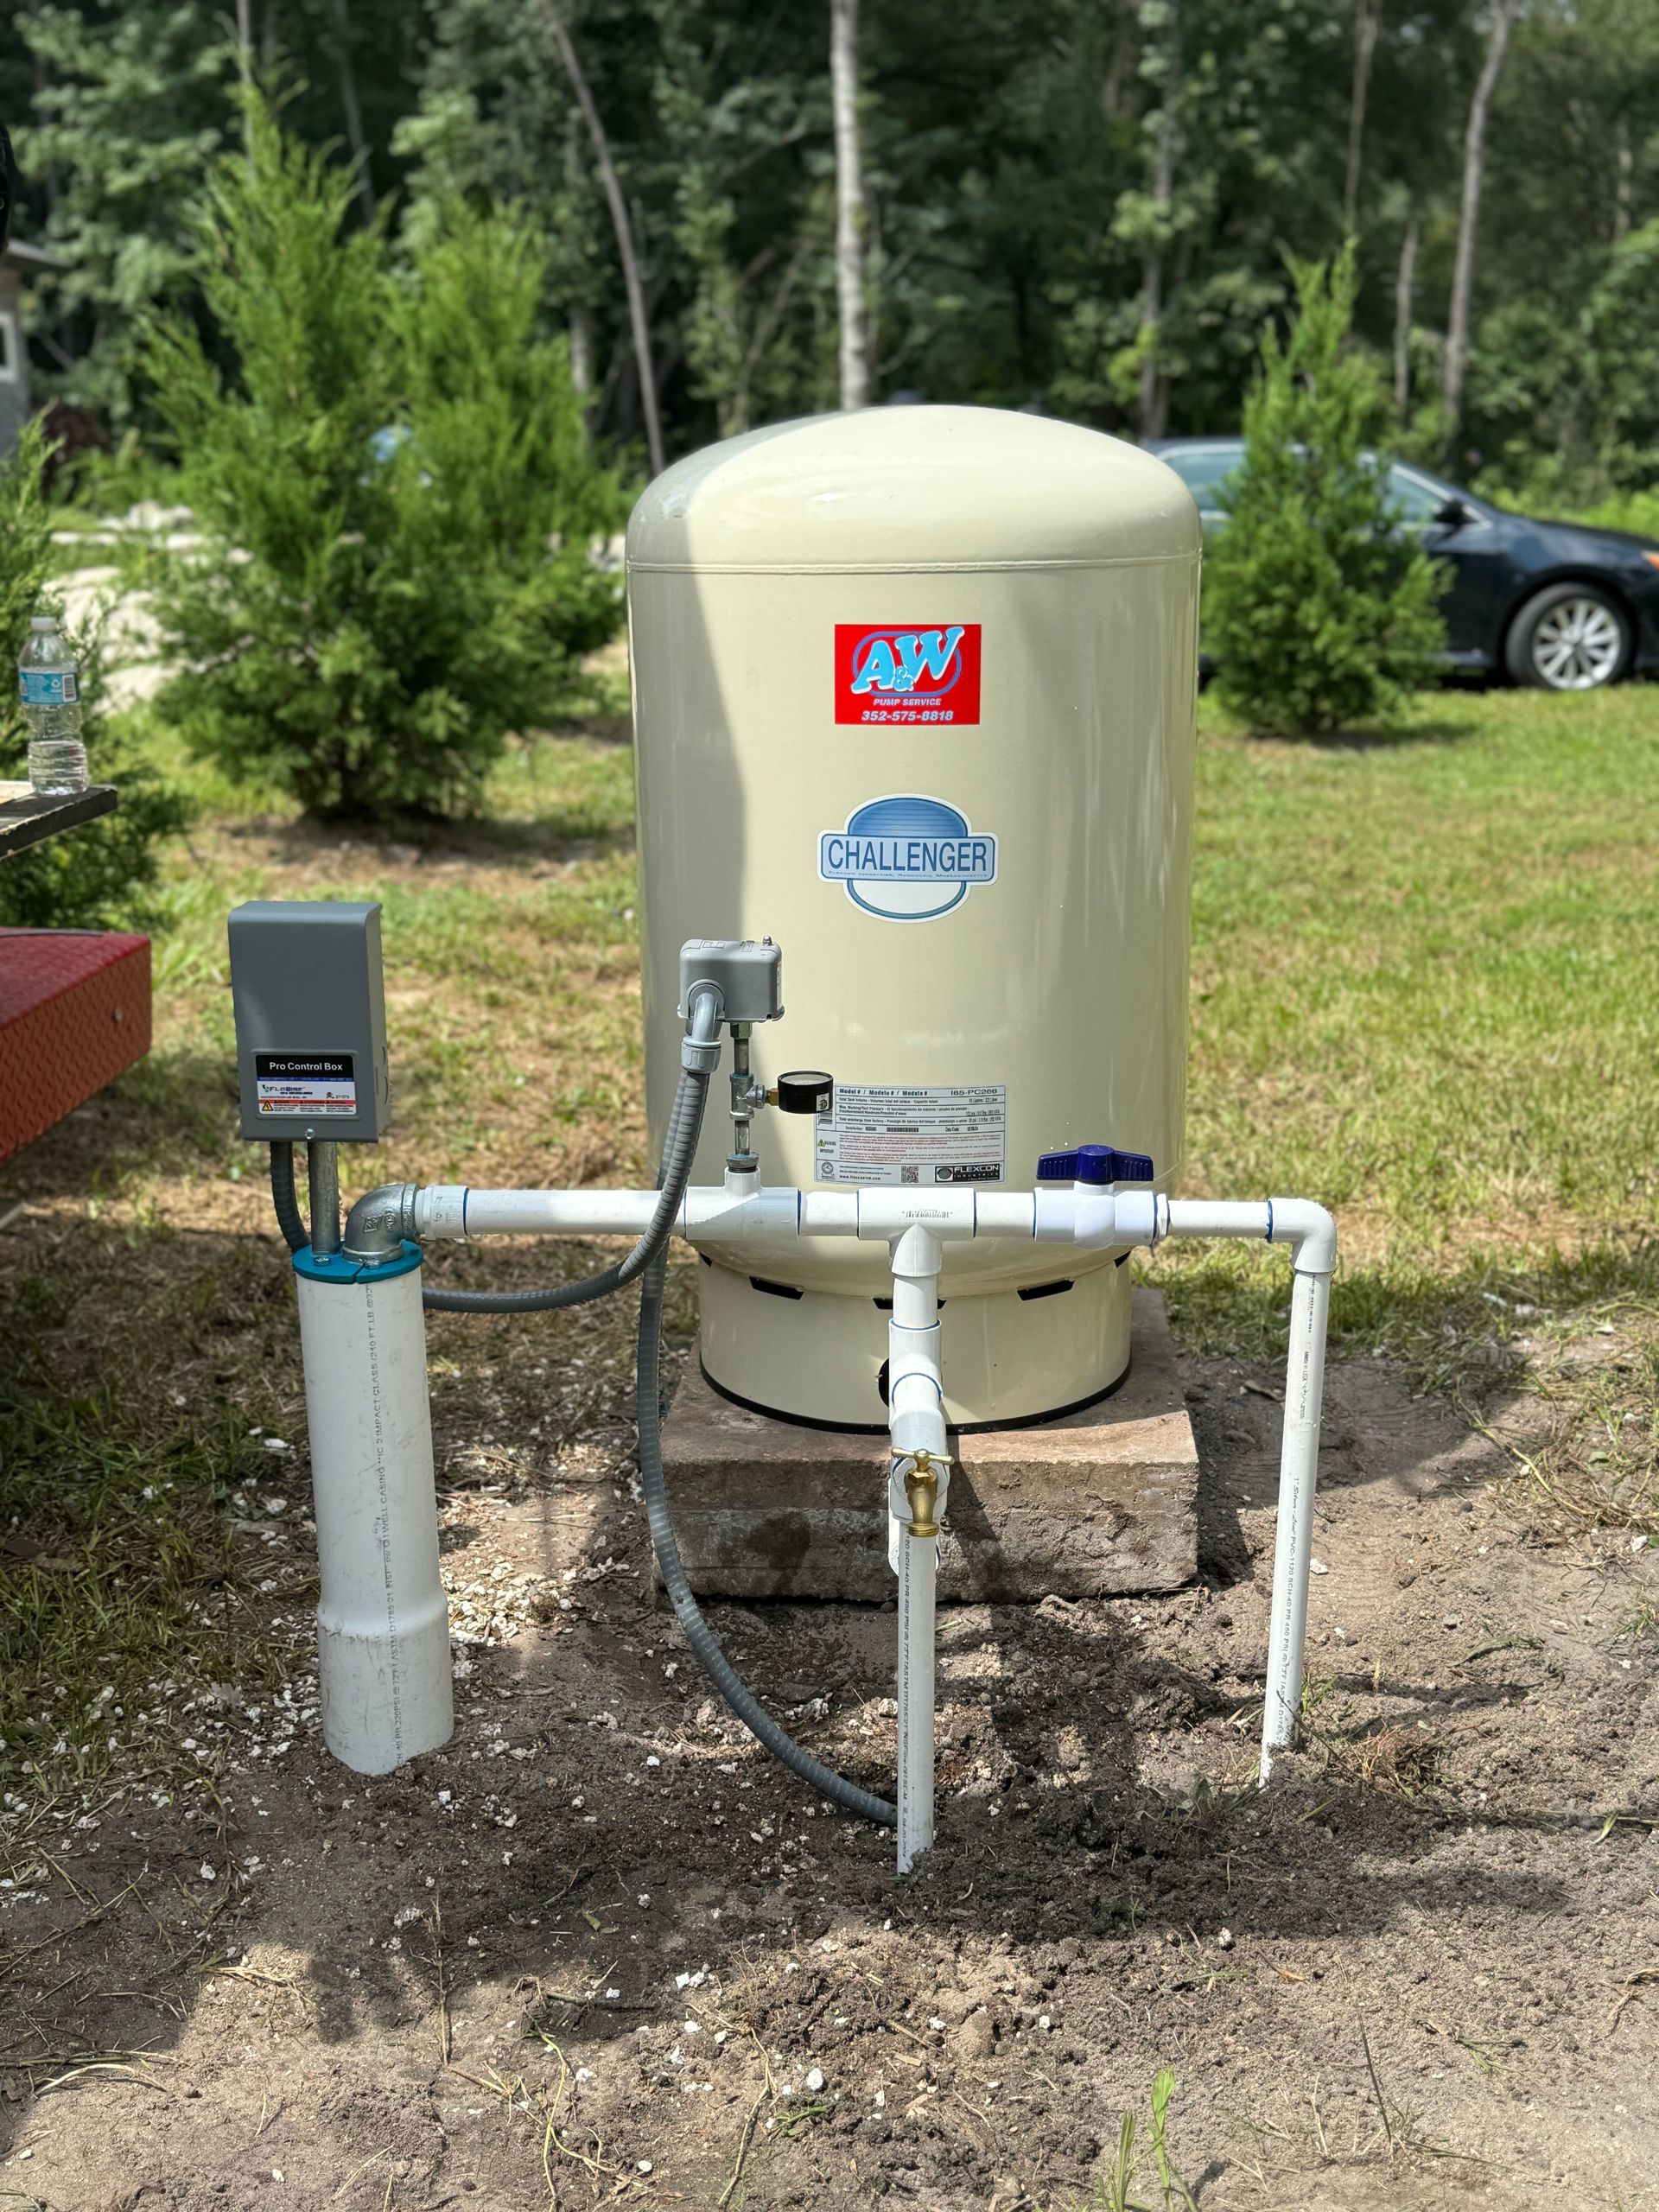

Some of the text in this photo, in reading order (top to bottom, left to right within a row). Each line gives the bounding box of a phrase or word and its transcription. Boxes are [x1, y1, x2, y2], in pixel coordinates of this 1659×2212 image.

[851, 626, 965, 694] A&W
[902, 697, 942, 706] SERVICE
[861, 709, 954, 721] 352-575-8818
[828, 839, 987, 872] CHALLENGER
[270, 1062, 286, 1071] Pro
[954, 1165, 999, 1173] FLEXCON
[371, 1363, 380, 1396] CLASS
[373, 1399, 383, 1437] IMPACT
[376, 1466, 387, 1504] CASING
[380, 1506, 389, 1533] WELL
[904, 1584, 910, 1597] PR
[387, 1605, 397, 1632] D1785
[1285, 1609, 1292, 1621] PR
[389, 1635, 398, 1660] ASTM
[394, 1753, 404, 1765] CH
